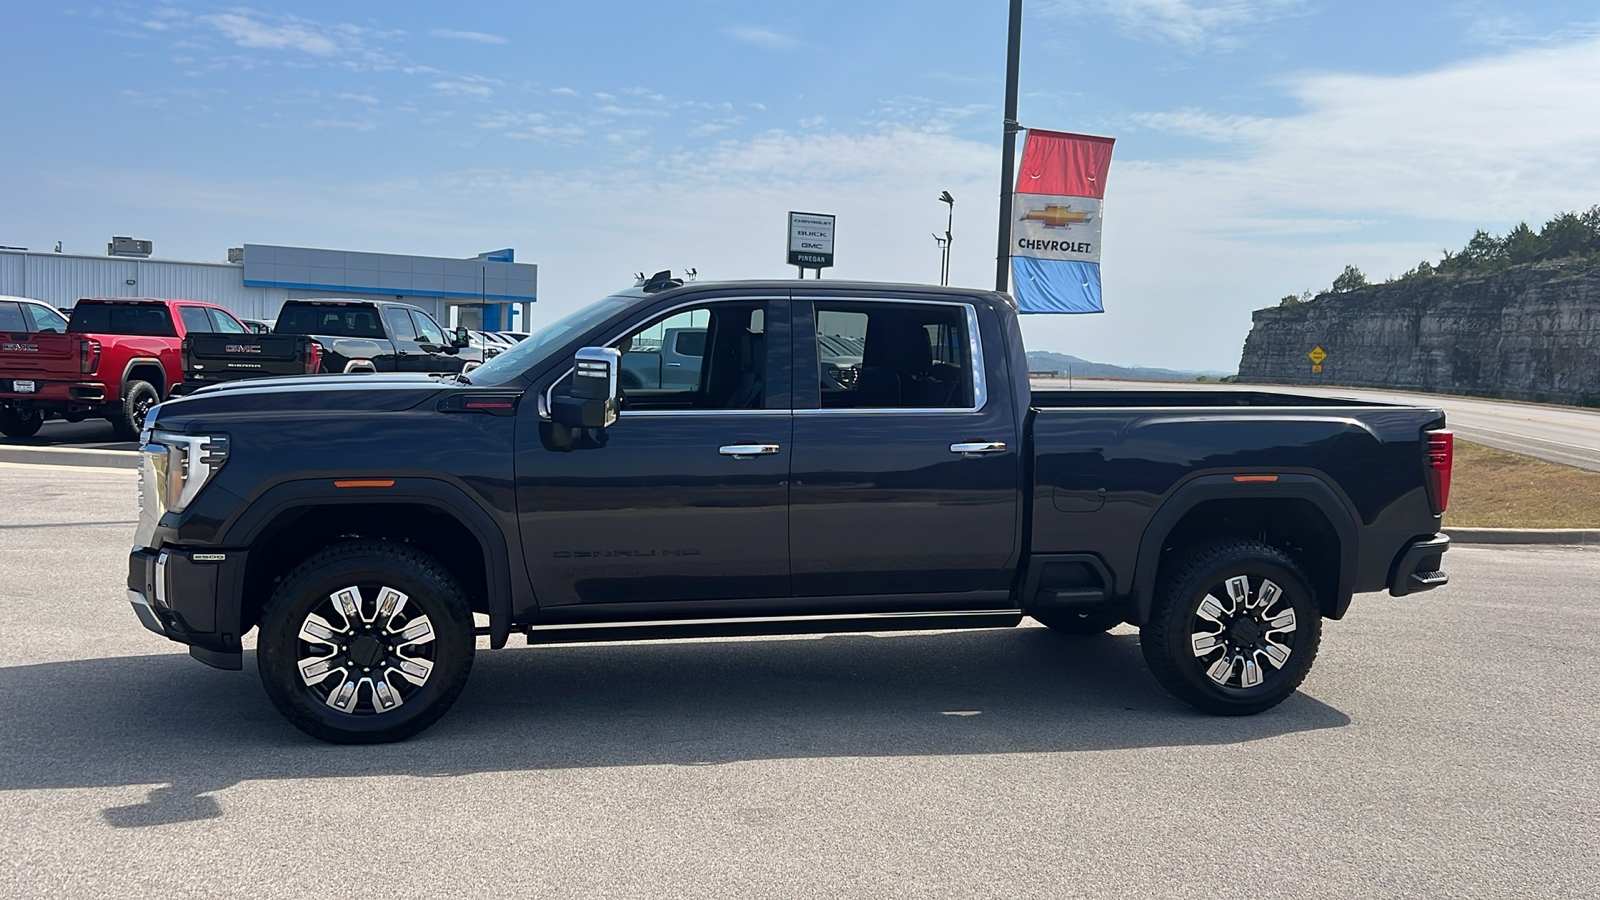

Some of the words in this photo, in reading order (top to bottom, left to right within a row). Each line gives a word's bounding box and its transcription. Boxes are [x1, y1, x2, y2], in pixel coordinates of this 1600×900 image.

[2, 343, 39, 352] GMC
[225, 344, 261, 353] GMC
[553, 550, 656, 558] DENALI
